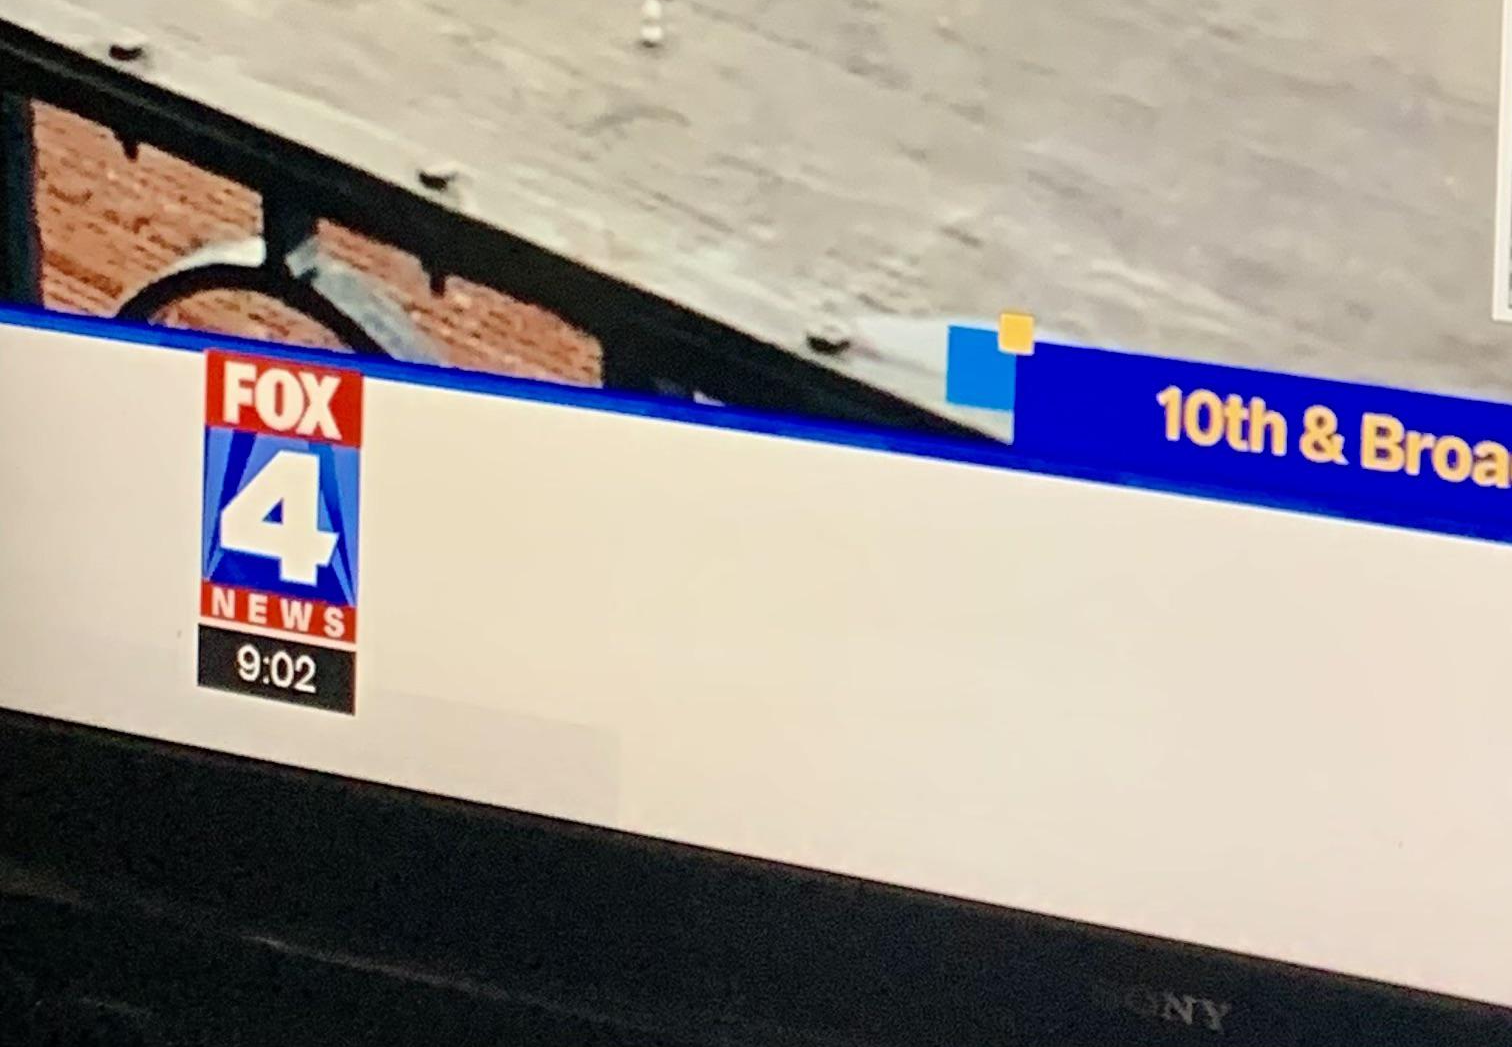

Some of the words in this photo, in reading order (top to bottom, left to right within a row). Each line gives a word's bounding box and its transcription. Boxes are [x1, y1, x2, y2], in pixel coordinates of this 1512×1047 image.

[222, 360, 342, 441] FOX
[1156, 385, 1287, 457] 10th
[1299, 404, 1349, 466] &
[219, 449, 340, 588] 4
[210, 586, 346, 639] NEWS
[235, 643, 318, 694] 9:02
